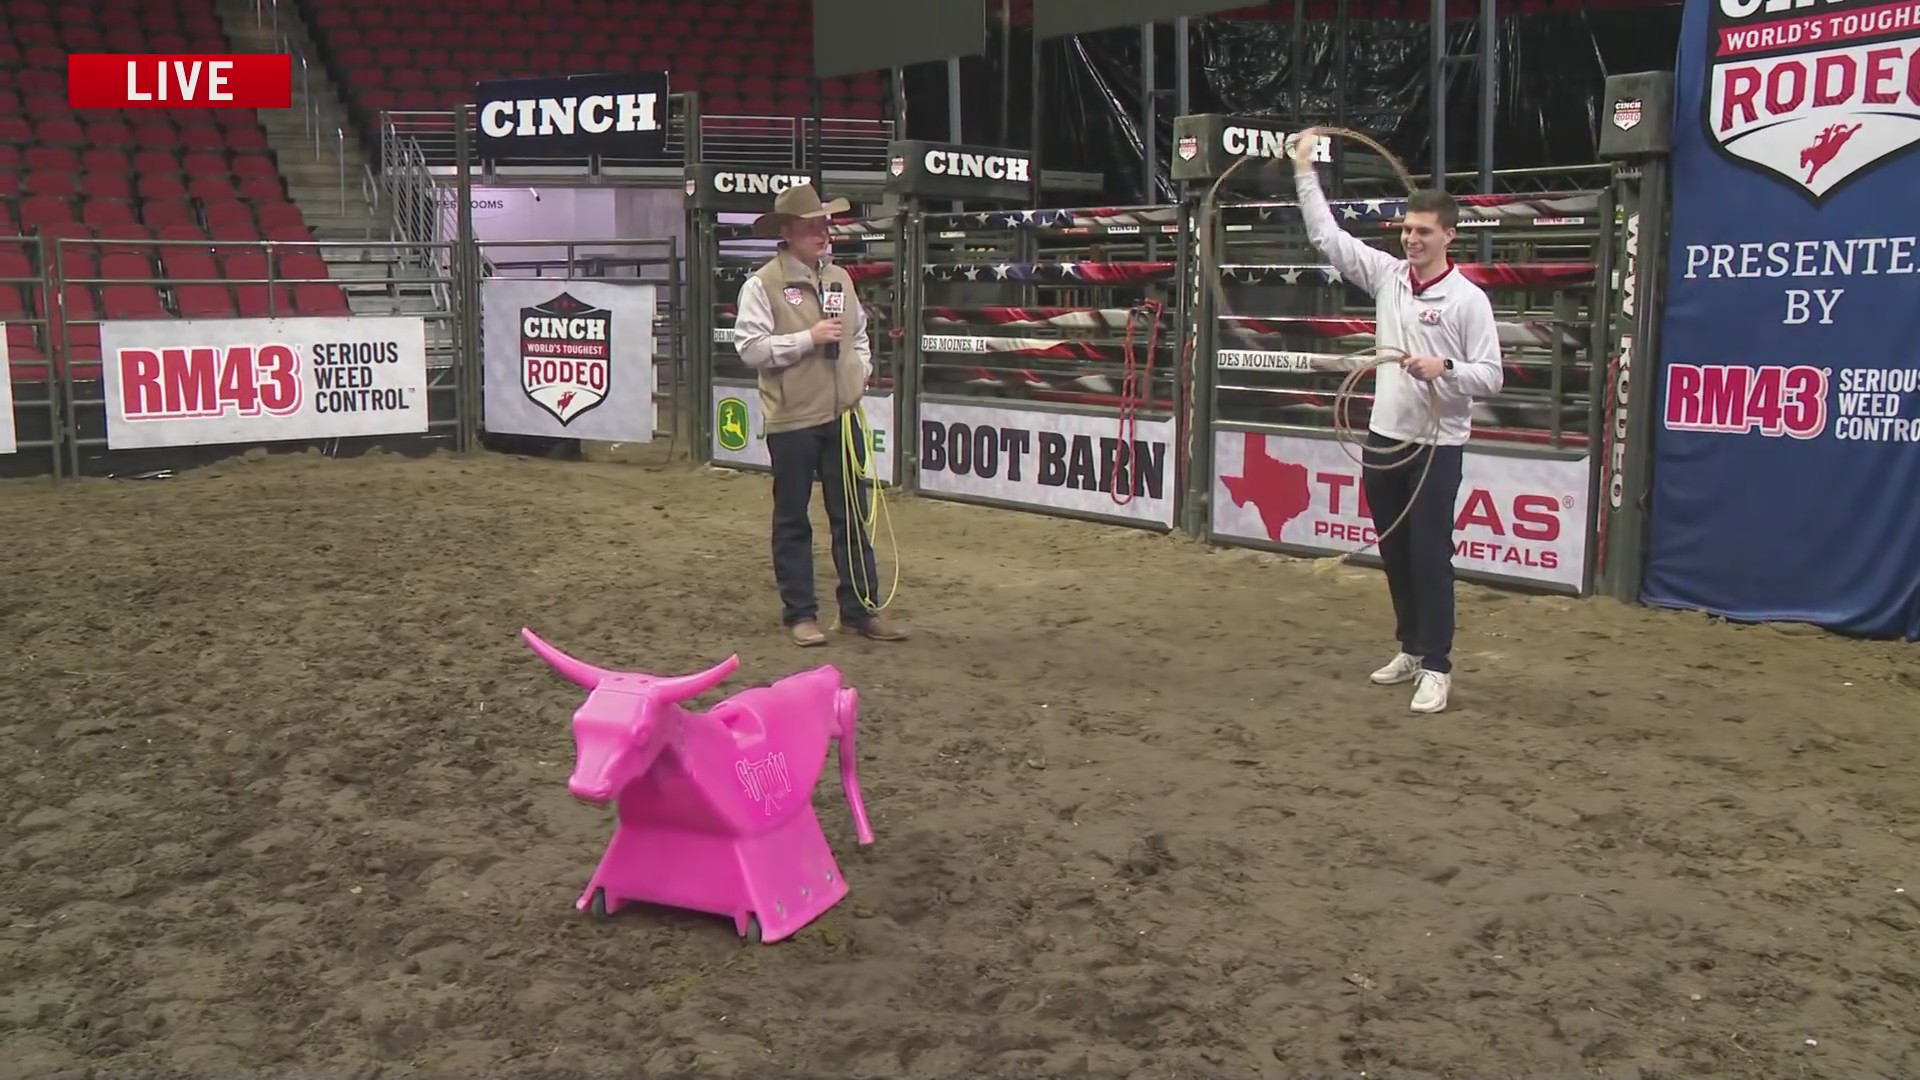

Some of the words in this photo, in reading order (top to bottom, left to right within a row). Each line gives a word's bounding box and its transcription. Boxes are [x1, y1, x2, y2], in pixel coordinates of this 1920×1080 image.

[1727, 21, 1822, 50] WORLD'S
[481, 93, 657, 138] CINCH
[1615, 113, 1640, 121] RODEO
[924, 150, 1029, 181] CINCH
[436, 200, 504, 209] RESOOMS
[1684, 237, 1920, 279] PRESENTE
[1783, 289, 1844, 324] BY
[524, 317, 605, 340] CINCH
[527, 343, 561, 354] WORLD'S
[563, 345, 603, 355] TOUGHEST
[922, 338, 938, 350] DES
[975, 340, 985, 352] IA
[528, 359, 604, 390] RODEO
[1219, 353, 1239, 367] DES
[1242, 354, 1292, 372] MOINES,
[1296, 356, 1309, 370] IA
[119, 345, 302, 420] RM43
[313, 342, 399, 366] SERIOUS
[314, 366, 373, 390] WEED
[316, 388, 410, 414] CONTROL
[1665, 363, 1829, 440] RM43
[1839, 368, 1920, 392] SERIOU
[1838, 393, 1900, 416] WEED
[921, 420, 1030, 482] BOOT
[1038, 431, 1166, 500] BARN
[1316, 472, 1561, 541] TAS
[1315, 521, 1379, 544] PREC
